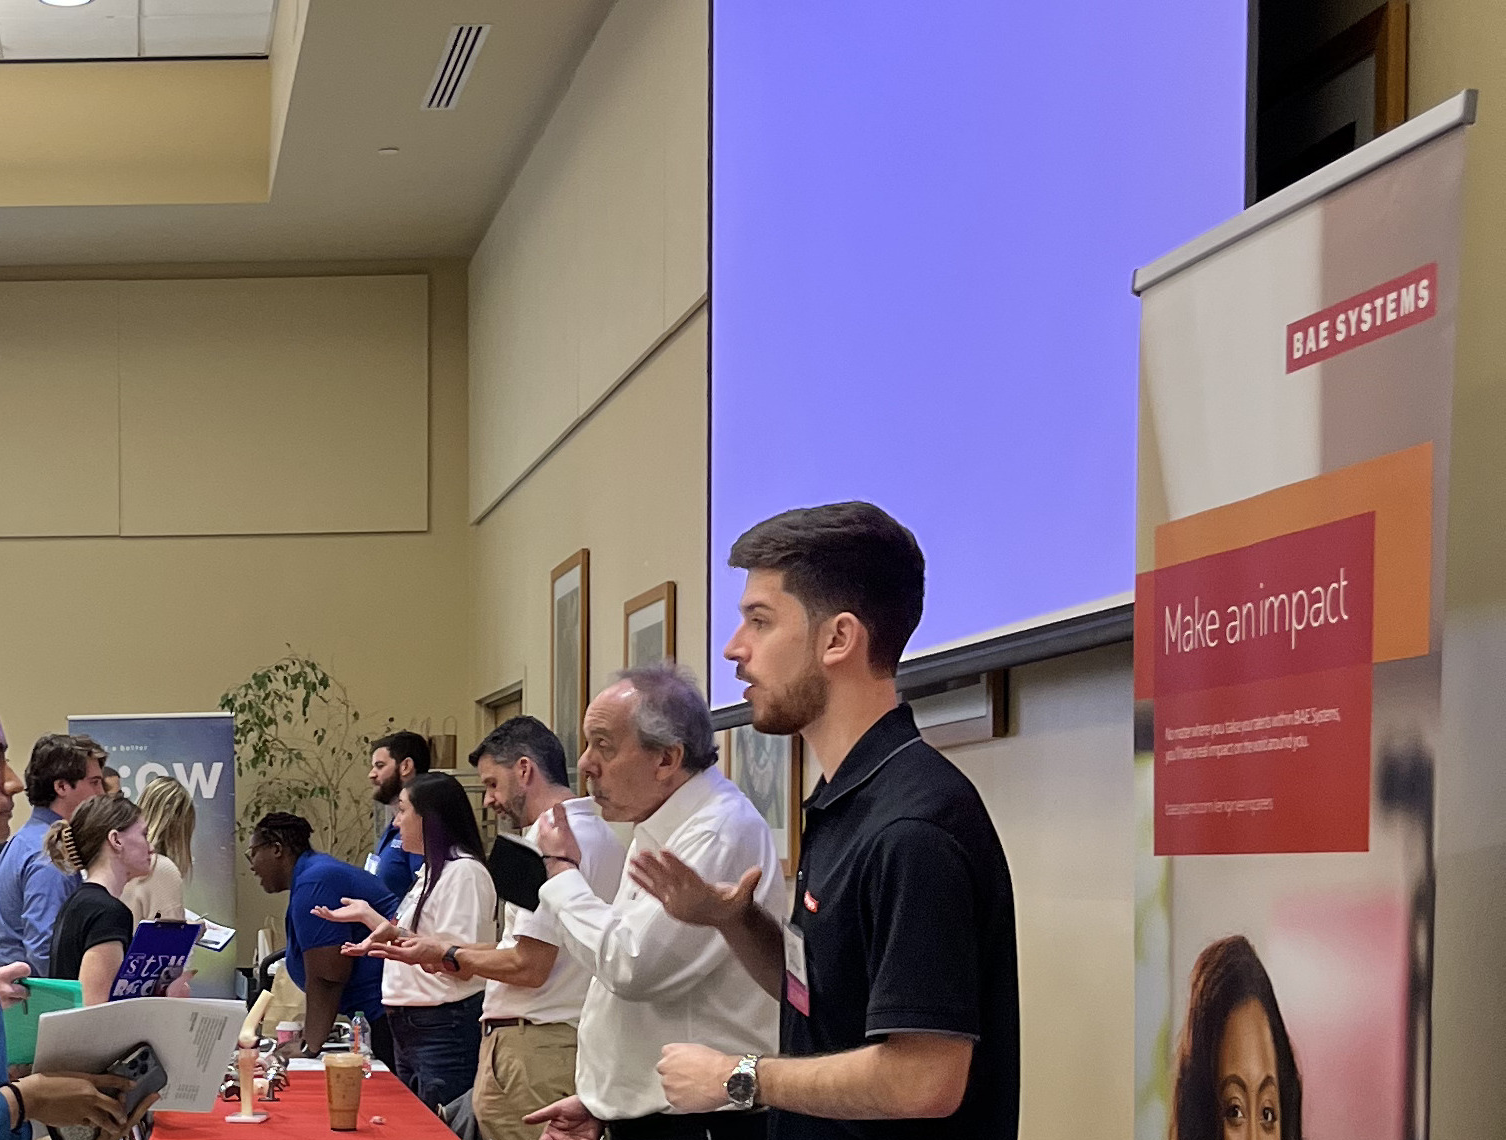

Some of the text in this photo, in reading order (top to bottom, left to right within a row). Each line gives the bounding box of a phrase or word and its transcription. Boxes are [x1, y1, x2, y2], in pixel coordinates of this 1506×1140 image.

[1292, 279, 1430, 360] BAE SYSTEMS
[1165, 568, 1349, 656] Make an impact
